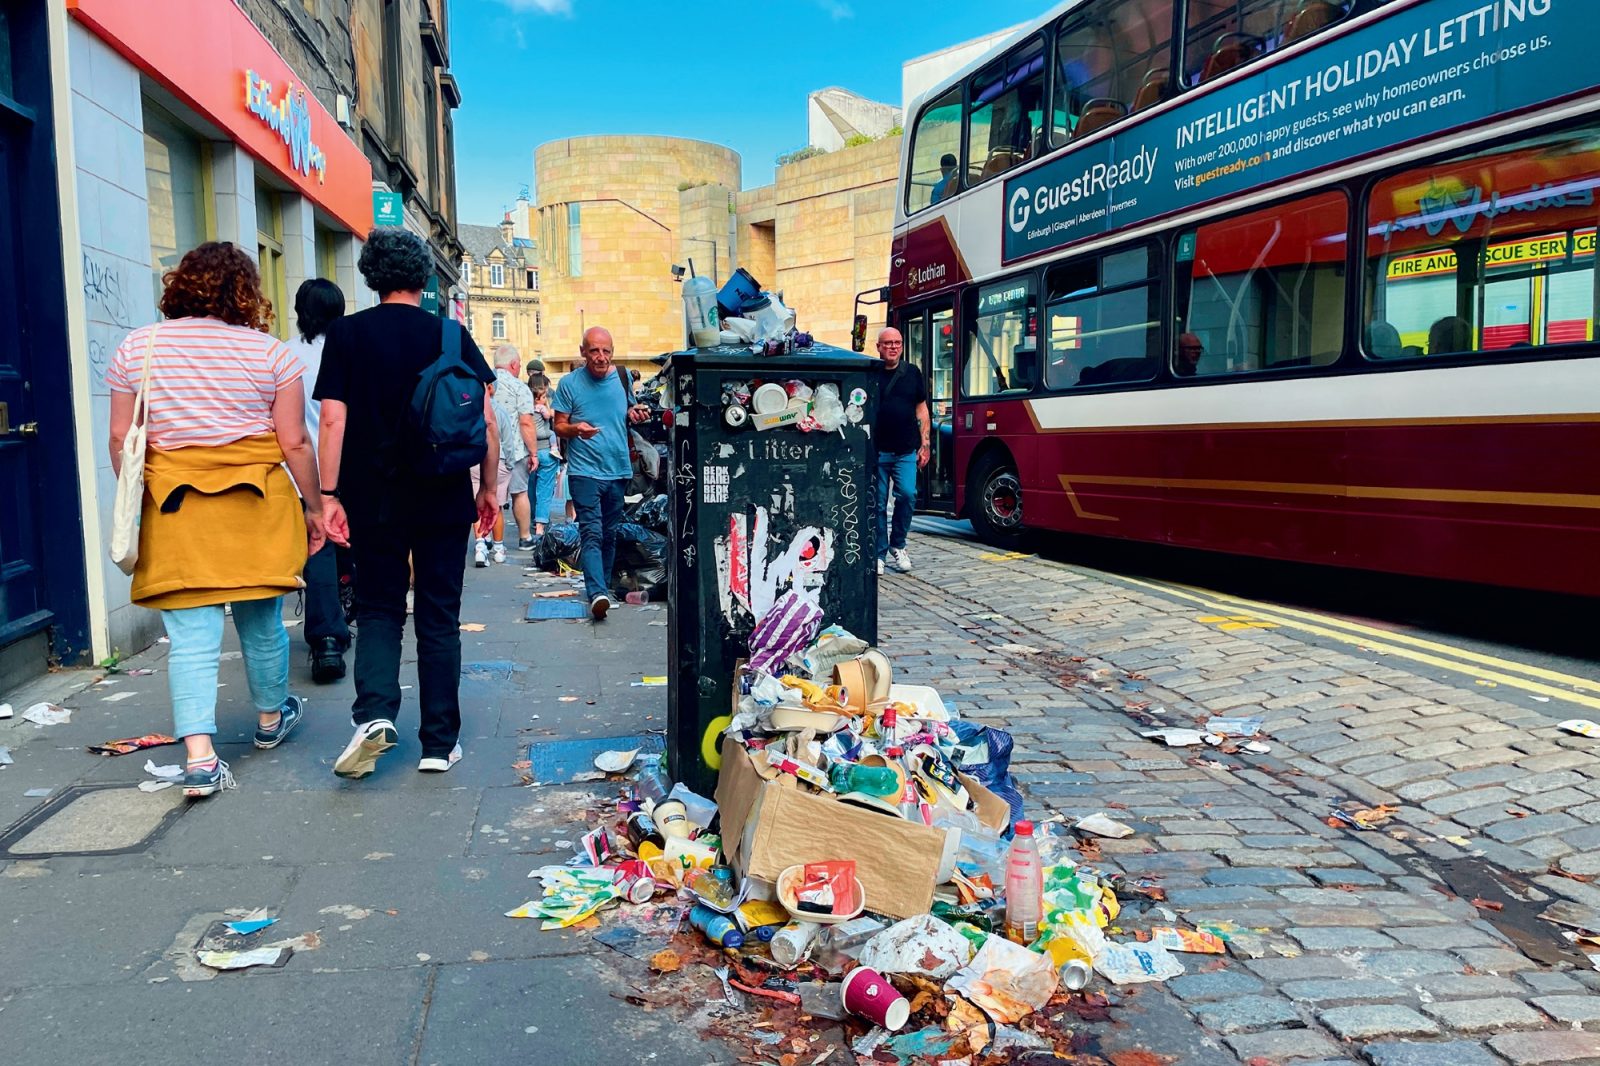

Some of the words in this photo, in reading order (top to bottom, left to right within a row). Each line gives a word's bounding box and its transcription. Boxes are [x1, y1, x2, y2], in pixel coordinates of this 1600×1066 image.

[1174, 154, 1196, 173] With
[1197, 150, 1217, 165] over
[1218, 133, 1258, 157] 200,000
[1260, 124, 1291, 144] happy
[1292, 111, 1330, 135] guests,
[1332, 102, 1353, 118] see
[1354, 92, 1380, 110] why
[1382, 61, 1470, 101] homeowners
[1473, 41, 1526, 70] choose
[1530, 34, 1552, 51] us.
[1176, 80, 1302, 149] INTELLIGENT
[1305, 33, 1418, 100] HOLIDAY
[1423, 0, 1551, 57] LETTING
[1174, 175, 1195, 191] Visit
[1195, 151, 1271, 187] guestready.com
[1272, 141, 1292, 159] and
[1293, 127, 1341, 152] discover
[1342, 114, 1374, 136] what
[1376, 107, 1400, 128] you
[1402, 99, 1427, 117] can
[1429, 88, 1466, 108] earn.
[1034, 144, 1158, 215] GuestReady
[1027, 224, 1051, 240] Edinburgh
[1054, 218, 1076, 232] Glasgow
[1078, 208, 1106, 223] Aberdeen
[1109, 197, 1137, 213] Inverness
[918, 262, 946, 284] Lothian
[1393, 259, 1422, 275] FIRE
[1426, 254, 1458, 271] AND
[1477, 245, 1523, 262] SCUE
